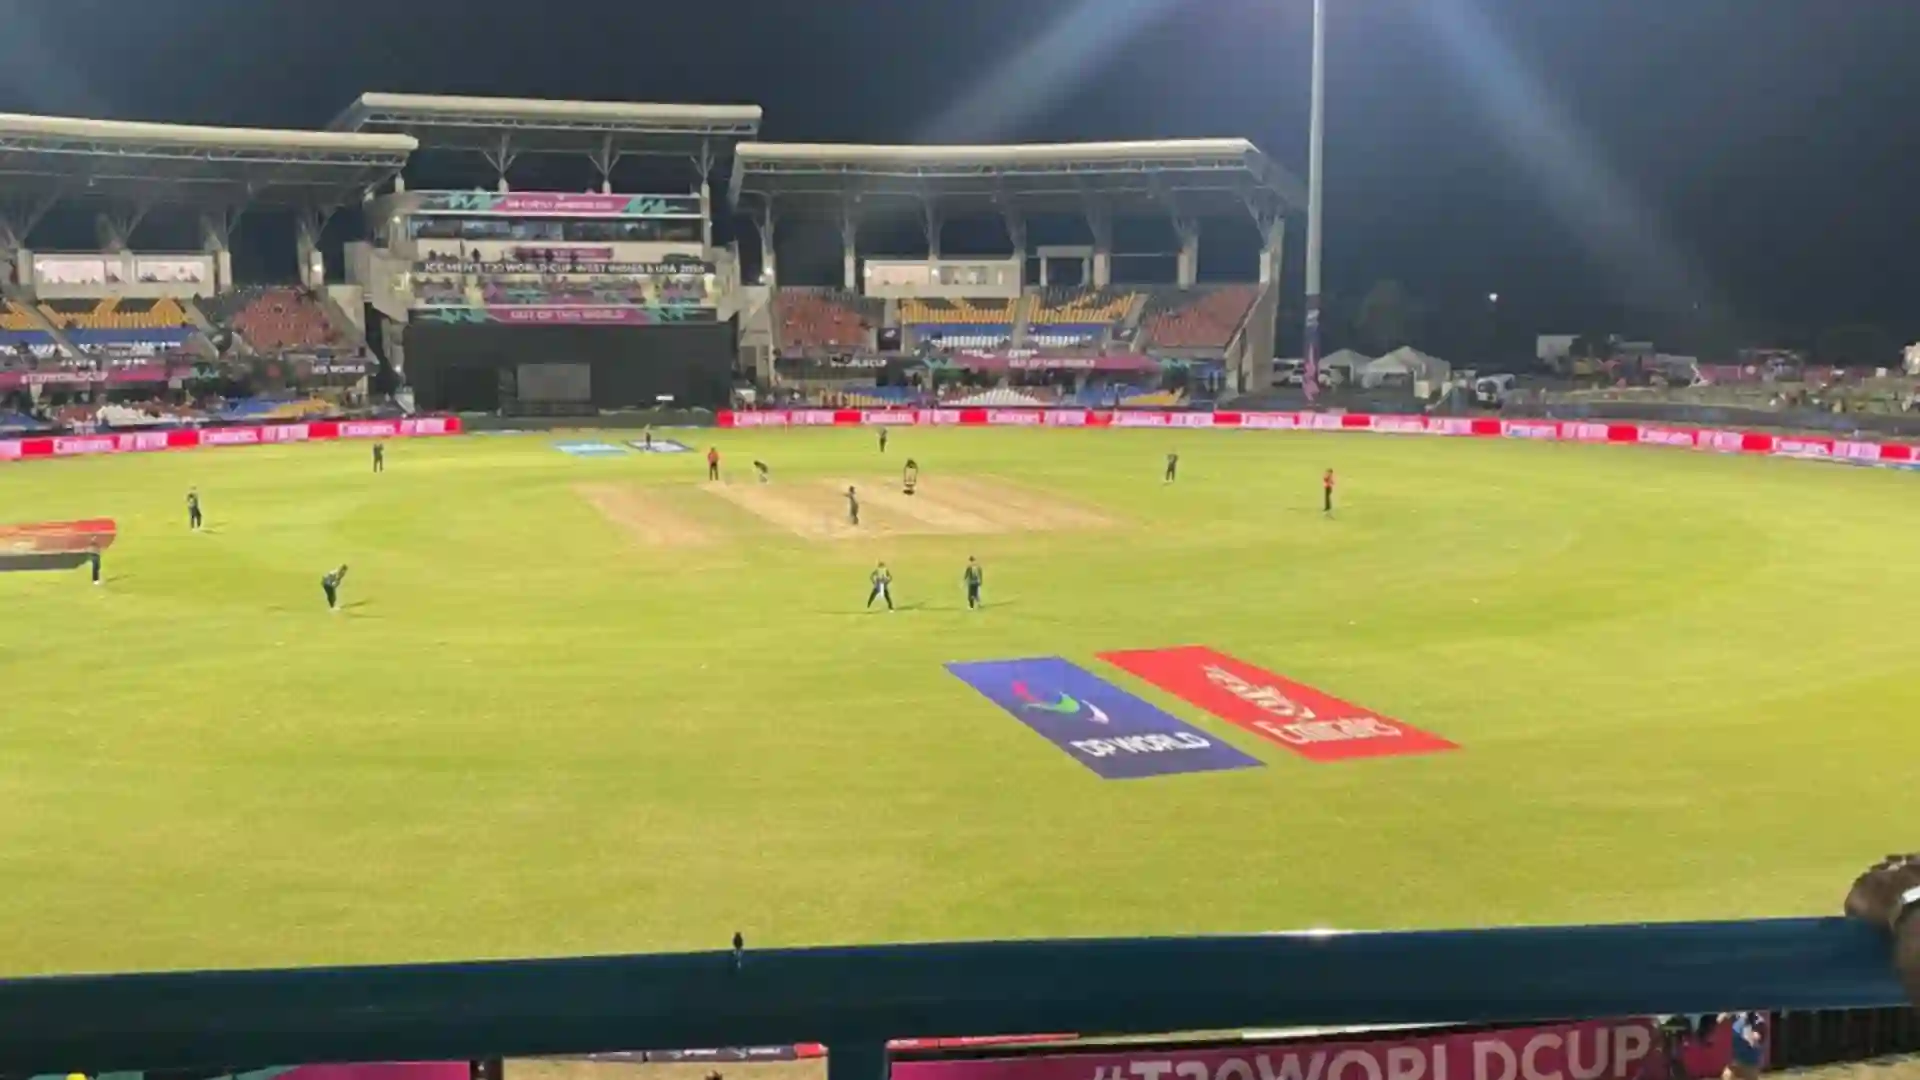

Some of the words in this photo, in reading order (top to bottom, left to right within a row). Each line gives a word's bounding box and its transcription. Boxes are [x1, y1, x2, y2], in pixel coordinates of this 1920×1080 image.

[505, 263, 548, 273] WORLD
[1070, 738, 1118, 757] DP
[1108, 732, 1210, 753] WORLD
[1093, 1025, 1651, 1080] WORLDCUP
